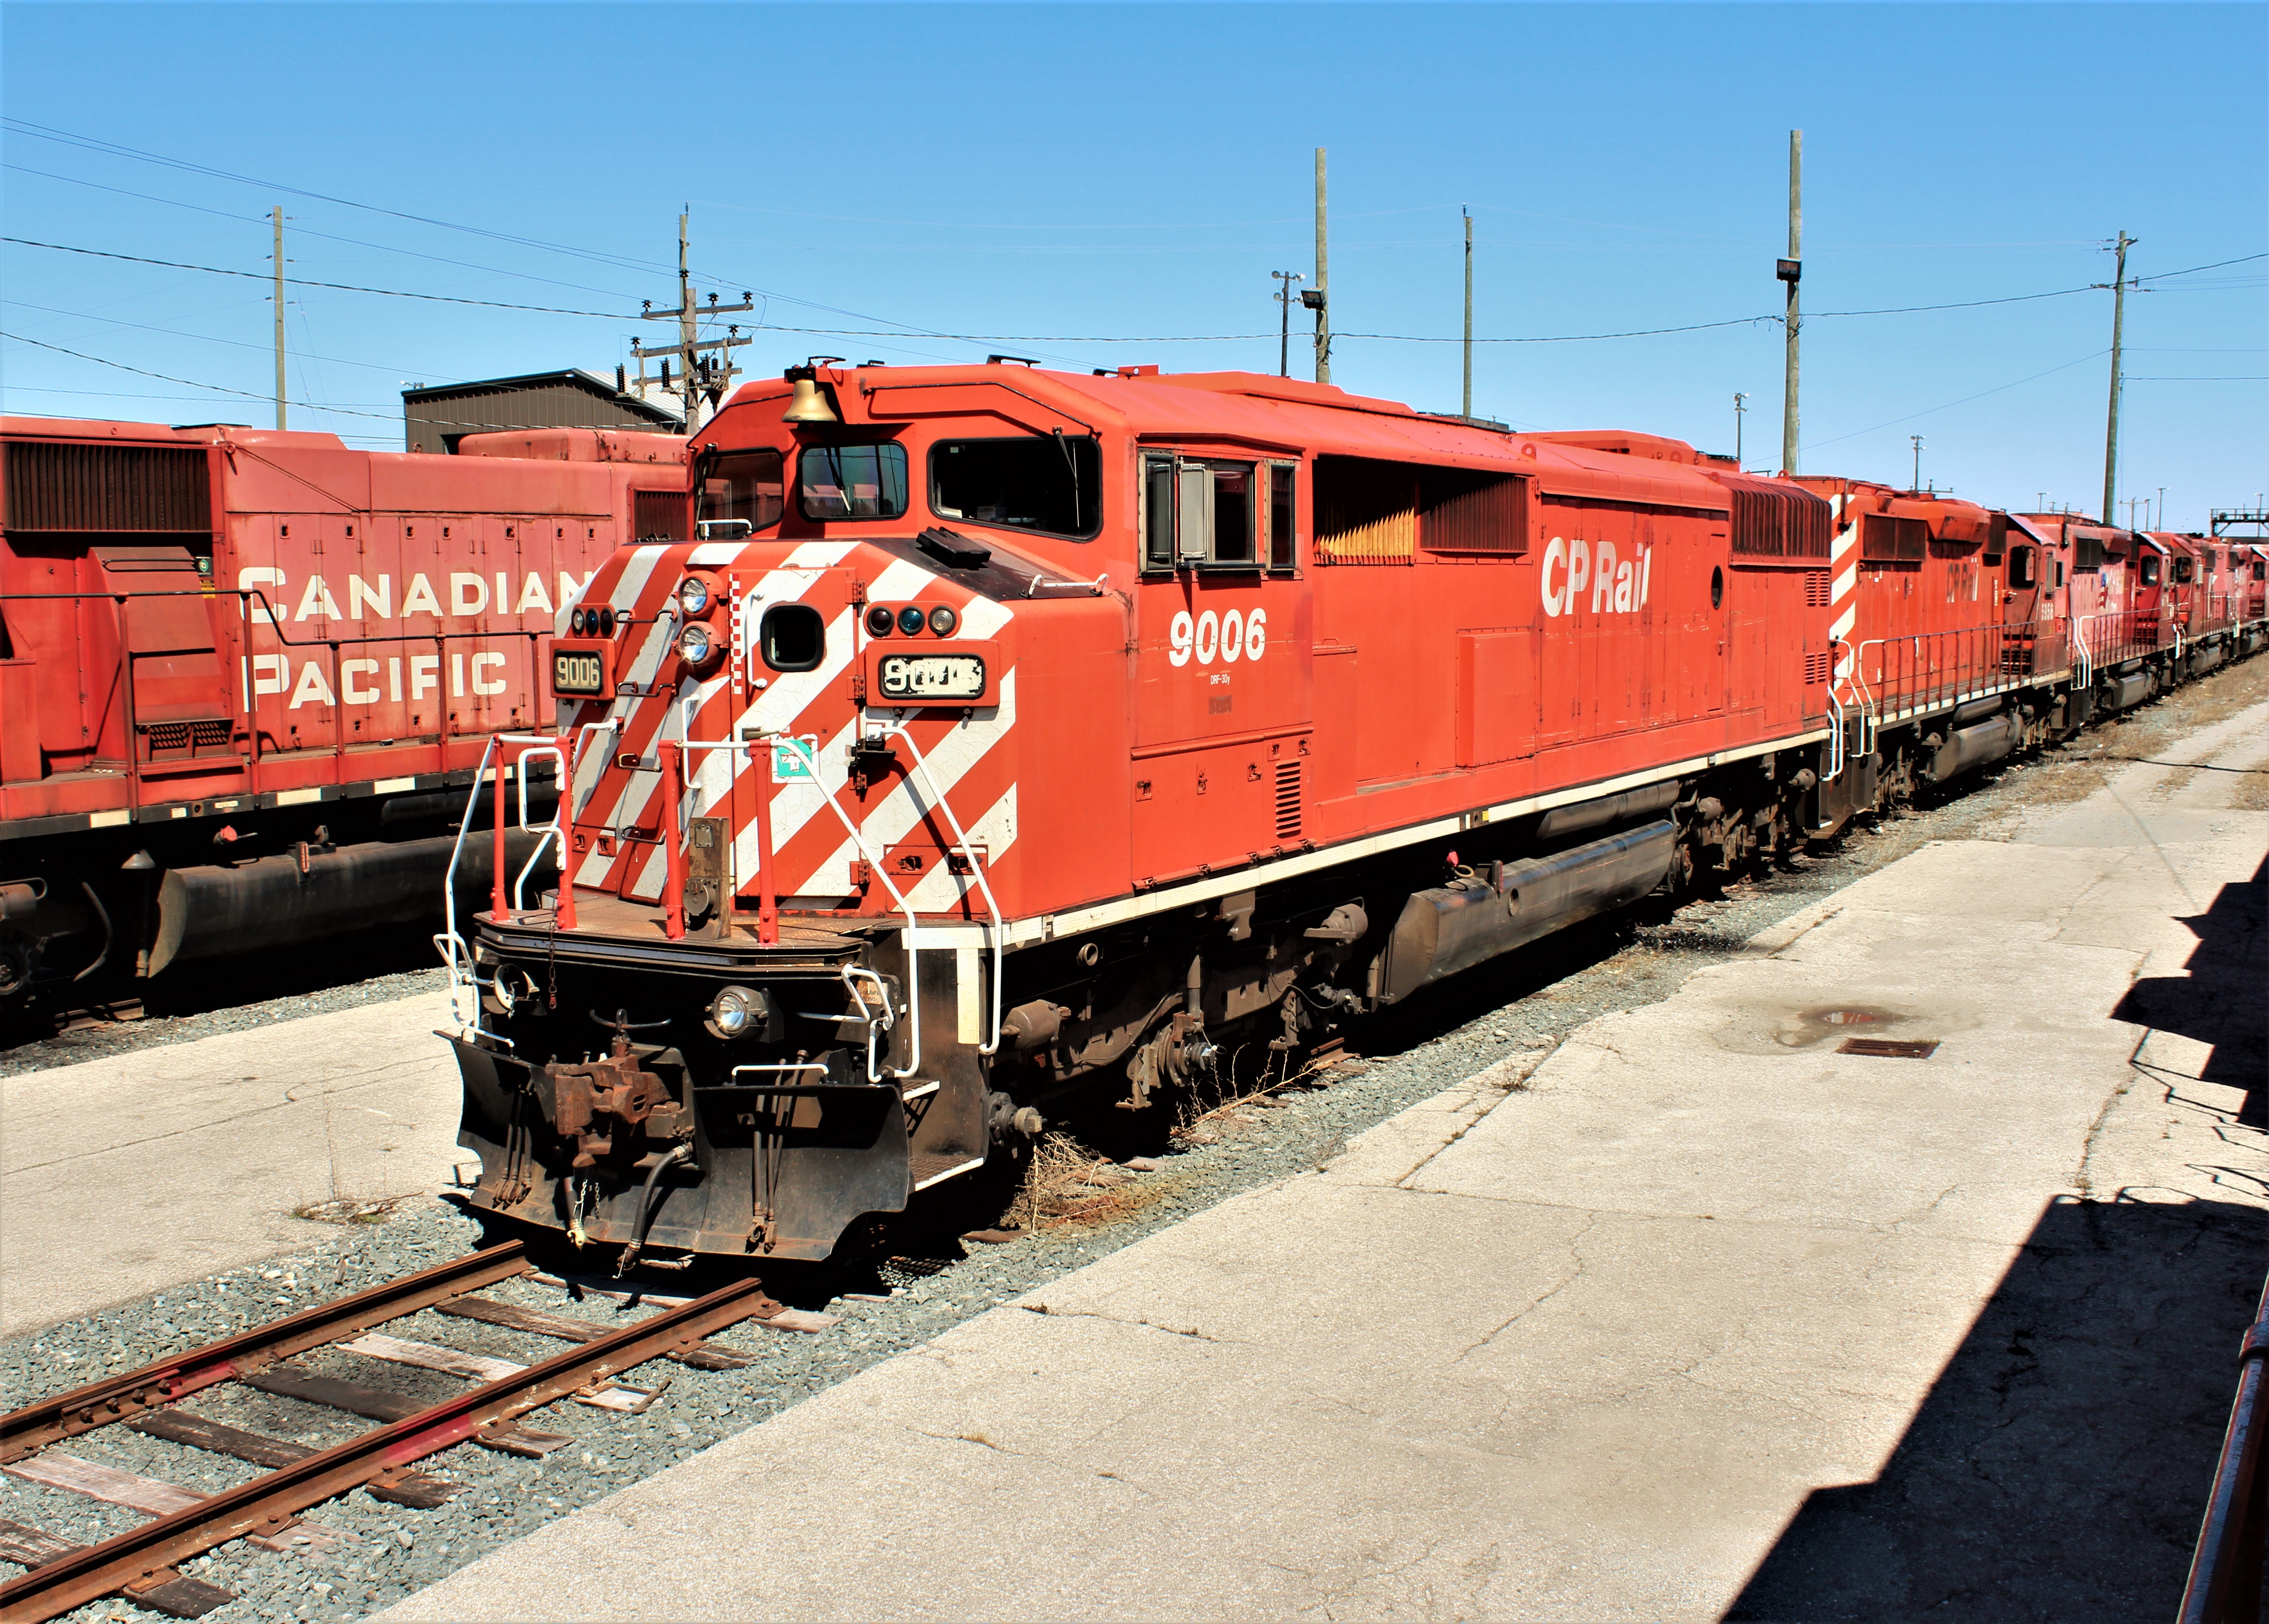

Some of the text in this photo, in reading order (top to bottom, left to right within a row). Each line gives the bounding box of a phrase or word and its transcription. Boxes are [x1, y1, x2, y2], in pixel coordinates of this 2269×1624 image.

[238, 567, 592, 624] CANADIAN
[1541, 536, 1651, 617] CP Rail
[1169, 608, 1267, 667] 9006
[241, 652, 507, 712] PACIFIC
[557, 657, 600, 686] 9006
[1210, 673, 1230, 685] DRF-30y
[1041, 914, 1054, 943] F
